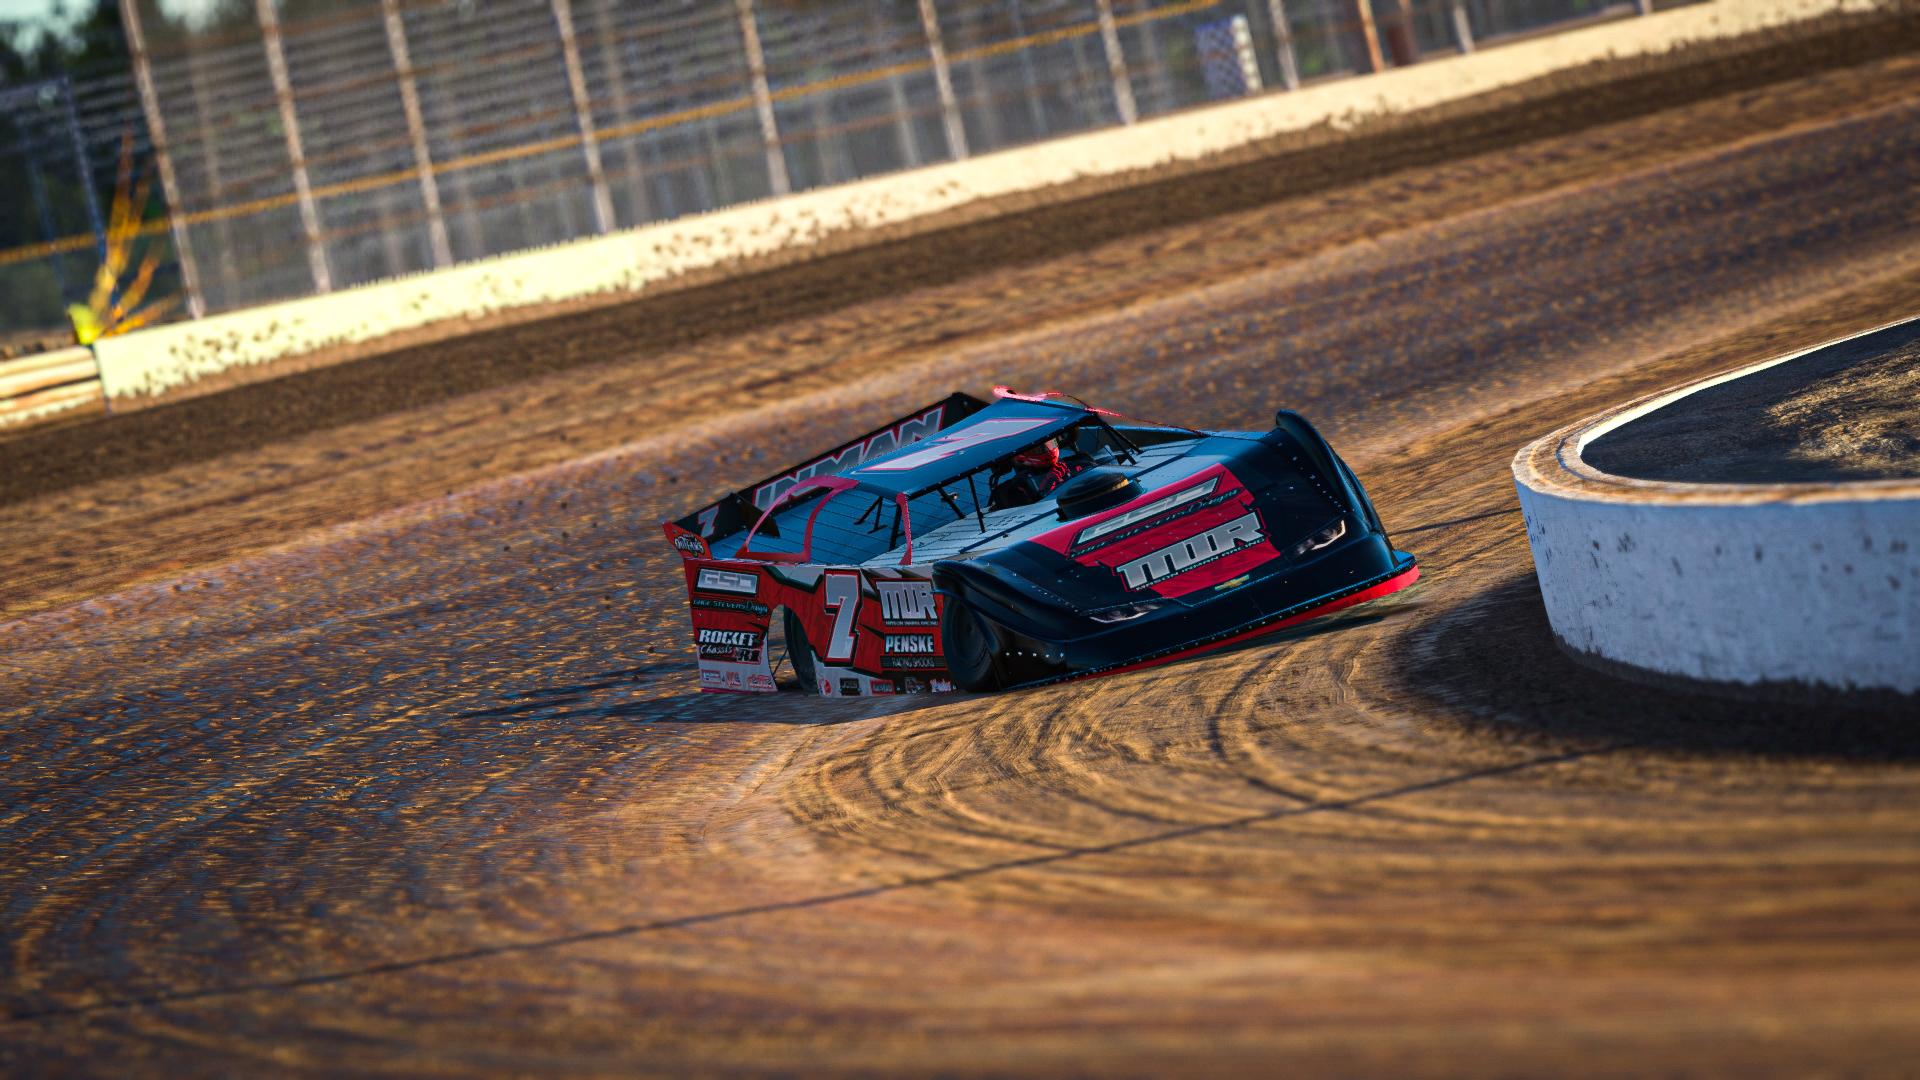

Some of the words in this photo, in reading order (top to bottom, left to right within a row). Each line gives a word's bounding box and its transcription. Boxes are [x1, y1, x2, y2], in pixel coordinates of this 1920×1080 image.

[753, 404, 945, 510] INMAN
[697, 505, 720, 538] 7
[824, 570, 862, 663] 7
[699, 629, 758, 647] ROCKET
[885, 634, 934, 653] PENSKE
